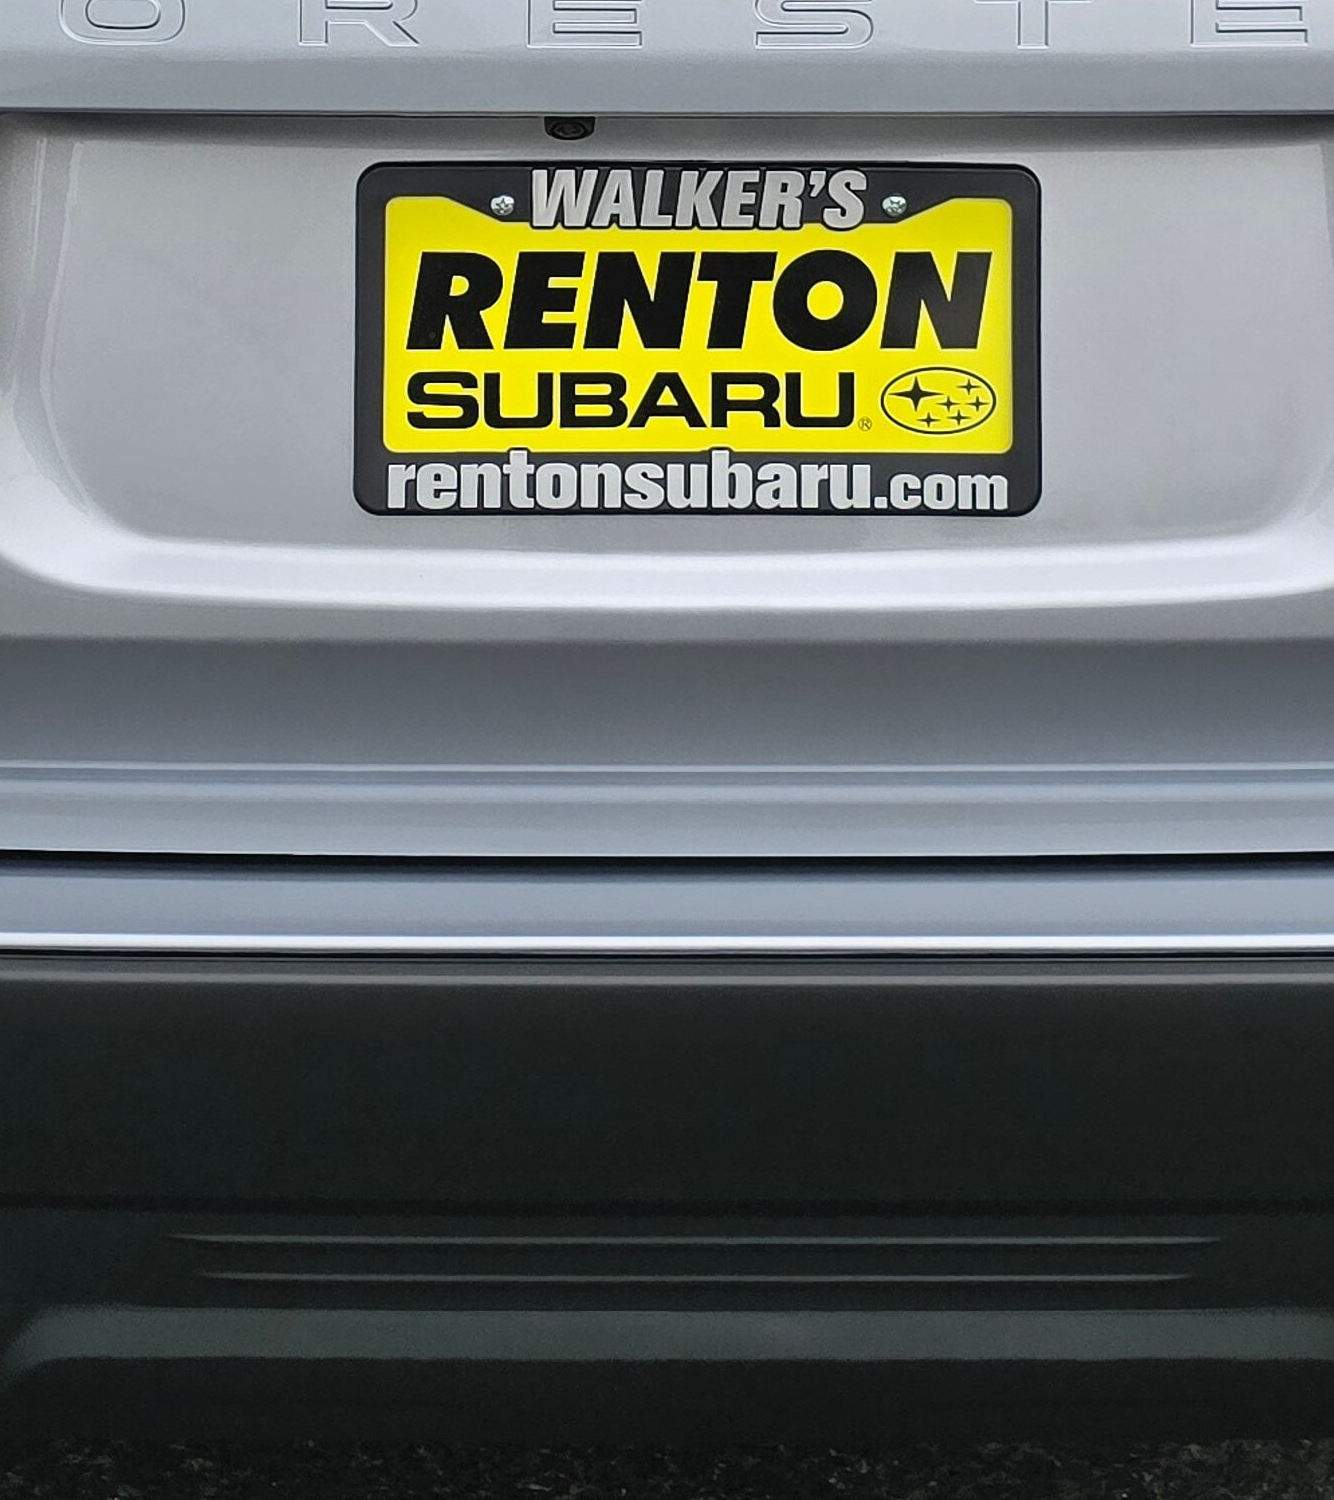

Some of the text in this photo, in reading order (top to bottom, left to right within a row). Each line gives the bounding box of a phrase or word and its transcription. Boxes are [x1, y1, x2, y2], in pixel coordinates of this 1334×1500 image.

[532, 168, 867, 230] WALKER'S
[406, 249, 993, 351] RENTON
[386, 449, 1009, 511] rentonsubaru.com
